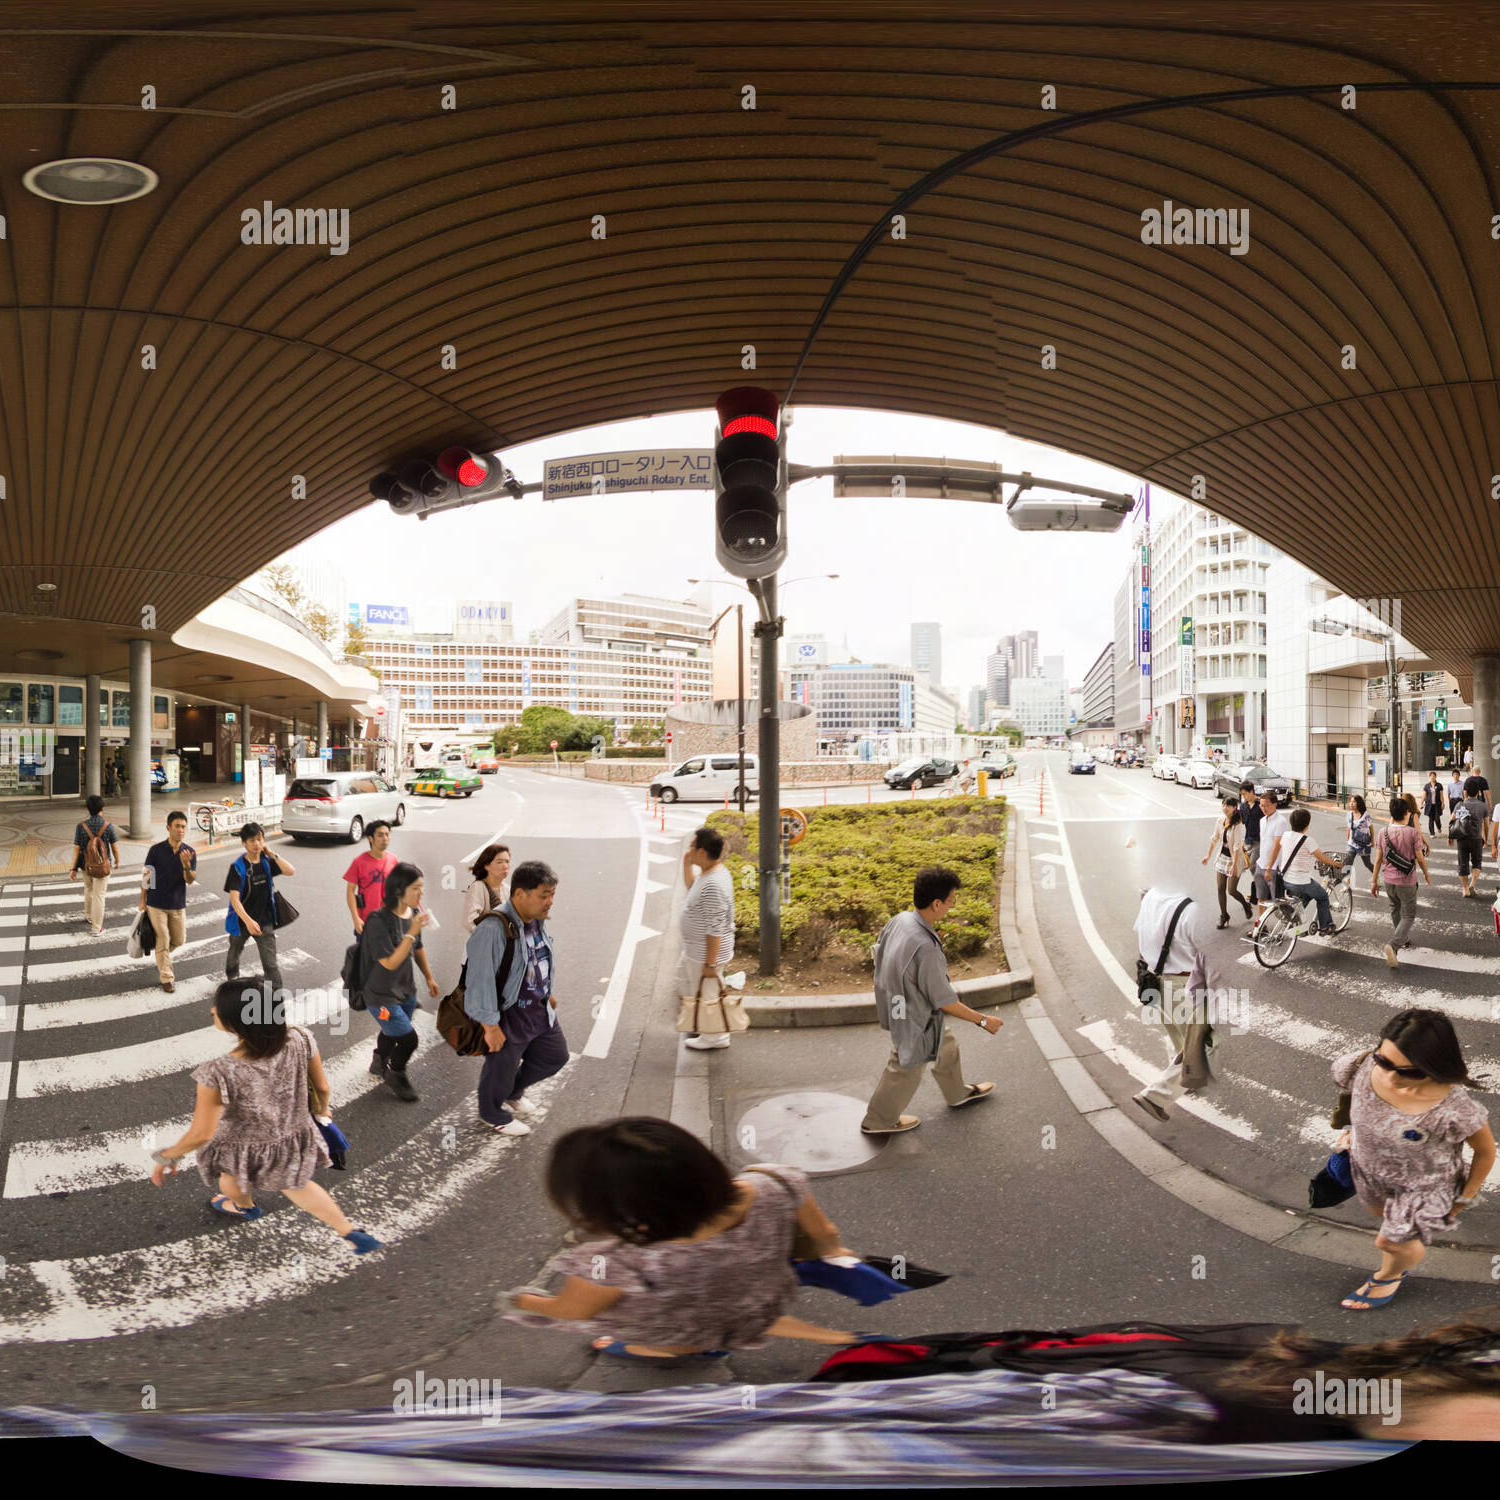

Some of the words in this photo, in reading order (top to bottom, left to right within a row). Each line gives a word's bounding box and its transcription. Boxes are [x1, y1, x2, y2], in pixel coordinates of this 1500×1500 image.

[547, 455, 711, 481] 新宿西口ロータリー入口
[548, 480, 592, 495] Shinjuku
[652, 474, 685, 486] Rotary
[689, 474, 709, 484] Ent.
[461, 606, 507, 620] ODAKYU
